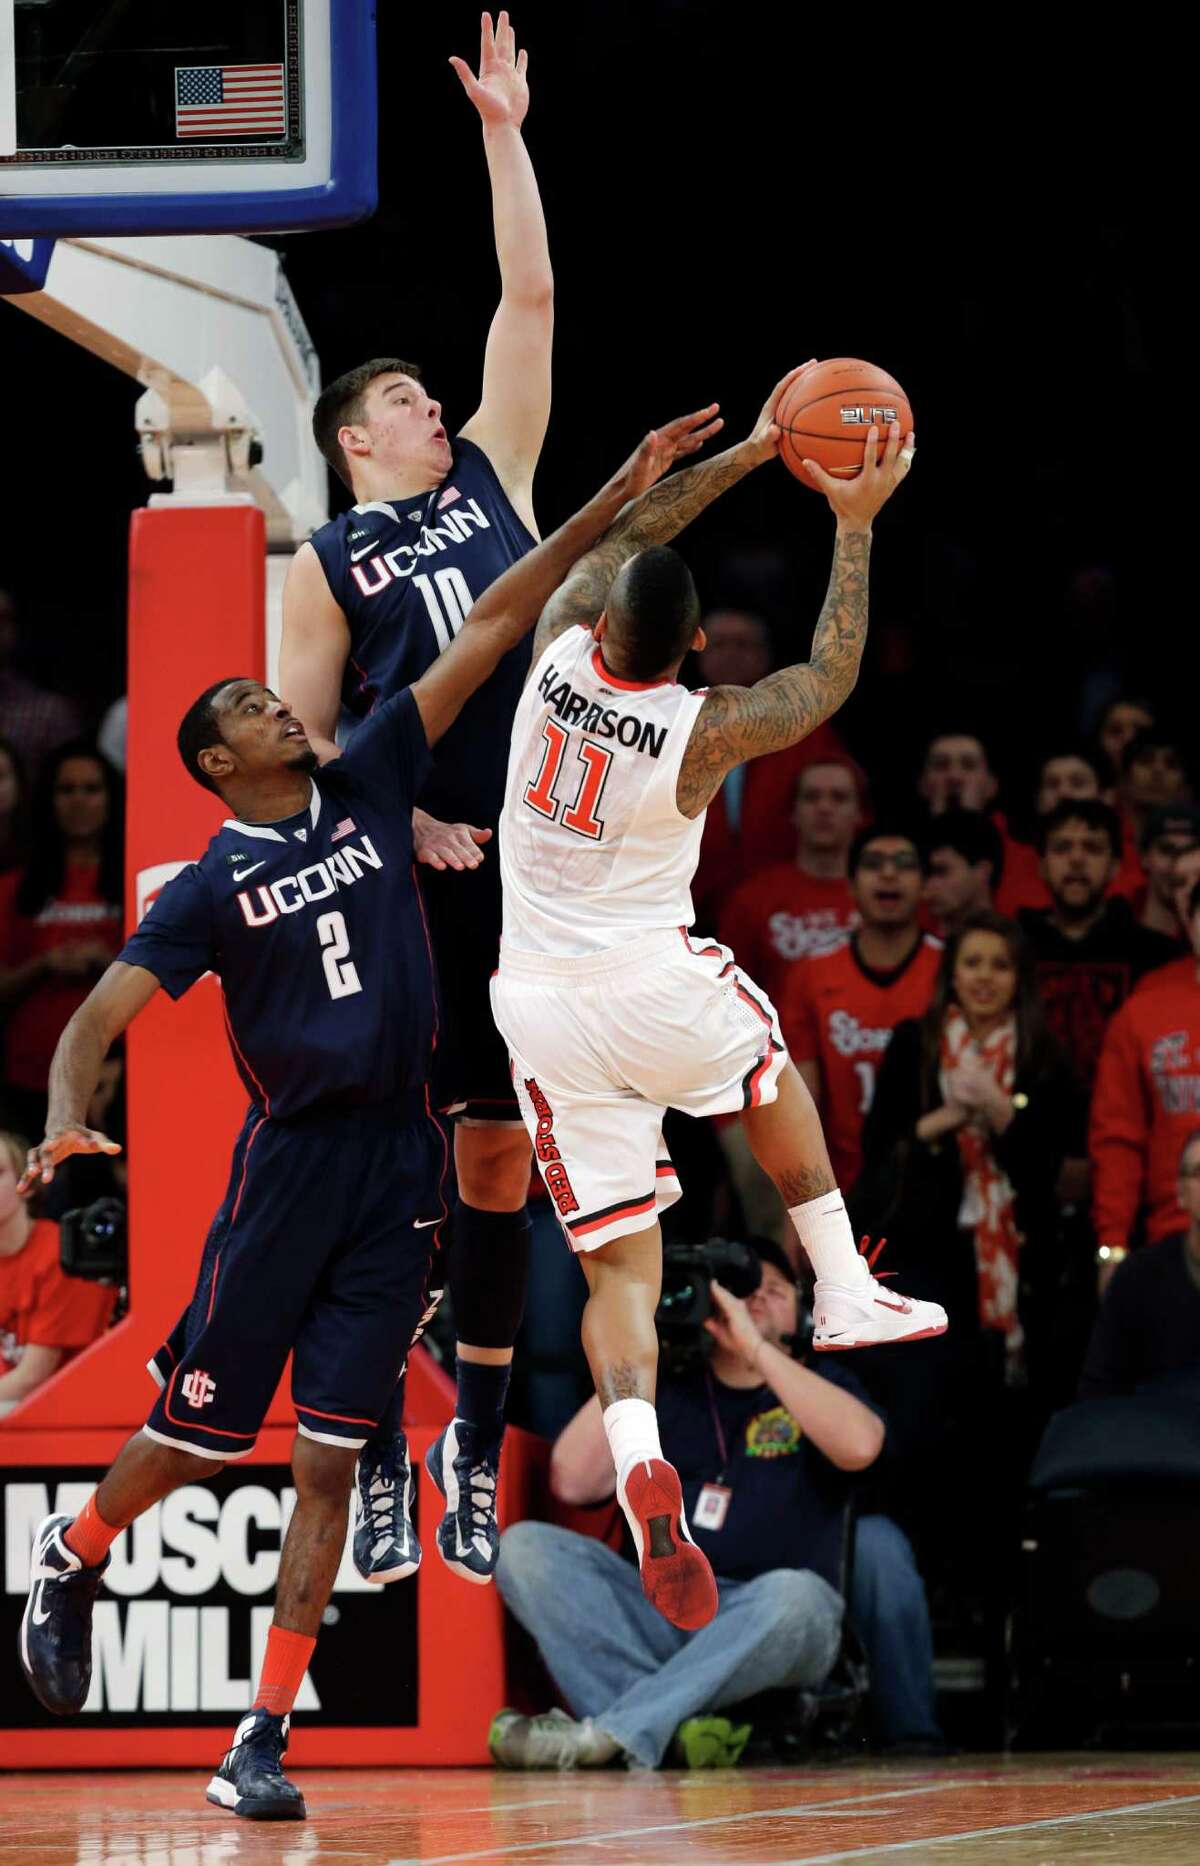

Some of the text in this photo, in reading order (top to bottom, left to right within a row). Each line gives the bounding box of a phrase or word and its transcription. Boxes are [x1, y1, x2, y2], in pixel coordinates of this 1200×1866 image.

[351, 498, 490, 597] UCONN
[412, 567, 475, 653] 10
[538, 664, 668, 759] HARRISON
[523, 716, 614, 841] 11
[236, 835, 384, 927] UCONN
[317, 911, 363, 1000] 2
[524, 1077, 580, 1216] RED STORM
